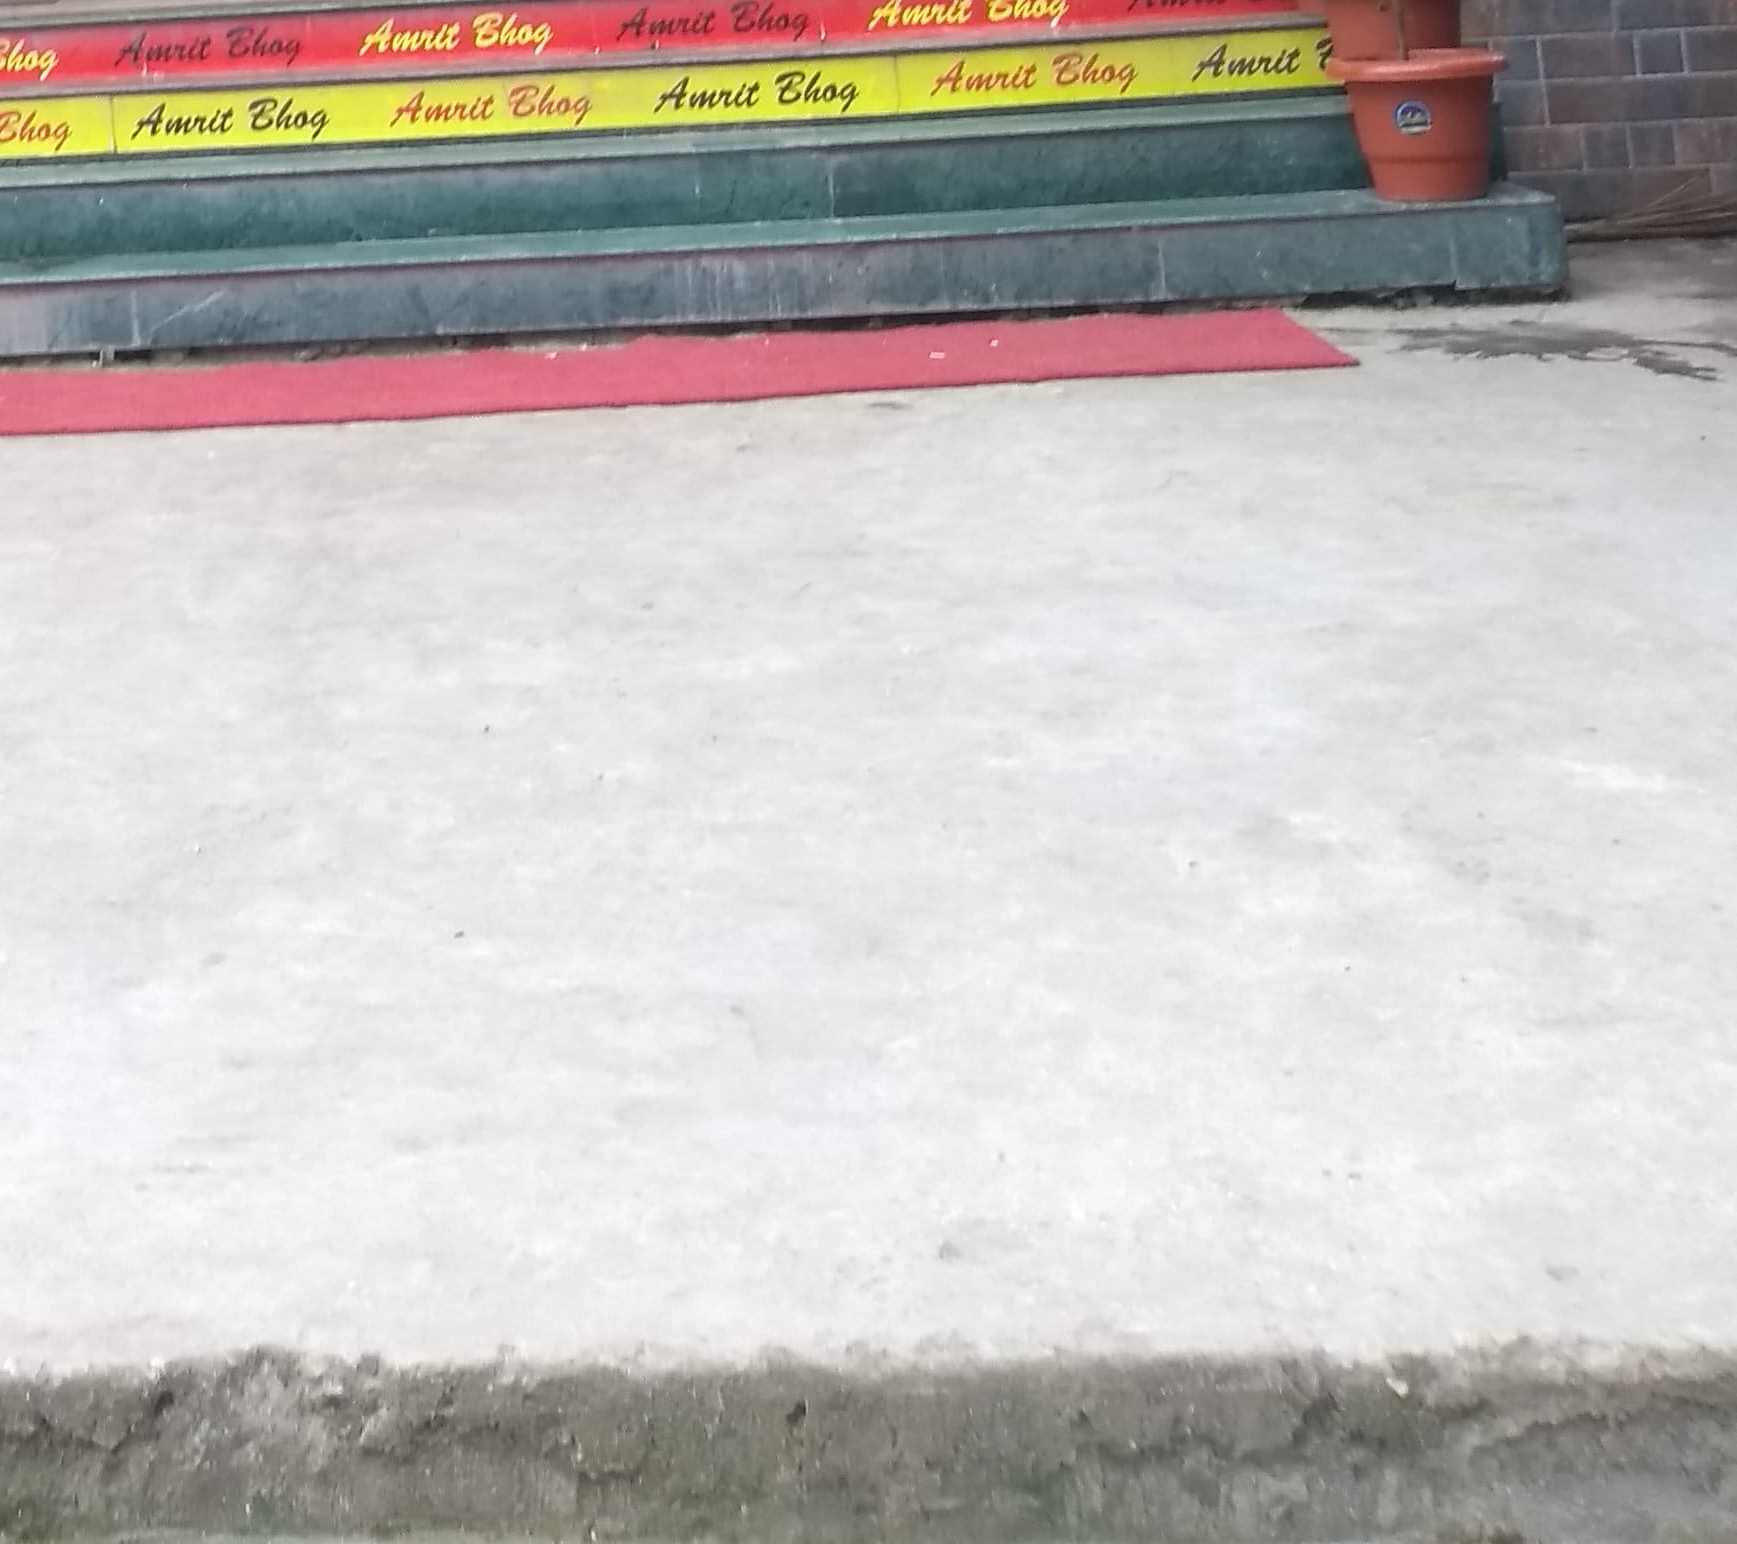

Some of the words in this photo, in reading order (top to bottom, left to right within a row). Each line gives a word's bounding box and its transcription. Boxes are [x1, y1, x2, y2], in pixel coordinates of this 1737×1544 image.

[113, 32, 212, 66] Amrit
[225, 26, 304, 65] Bhog
[359, 19, 459, 56] Amrit
[471, 12, 555, 56] Bhog
[616, 6, 714, 42] Amrit
[730, 0, 810, 42] Bhog
[131, 102, 233, 140] Amrit
[246, 98, 330, 141] Bhog
[388, 90, 495, 128] Amrit
[508, 83, 592, 127] Bhog
[653, 76, 760, 114] Amrit
[774, 70, 861, 112] Bhog
[930, 59, 1038, 97] Amrit
[1052, 53, 1138, 93] Bhog
[1191, 44, 1301, 82] Amrit
